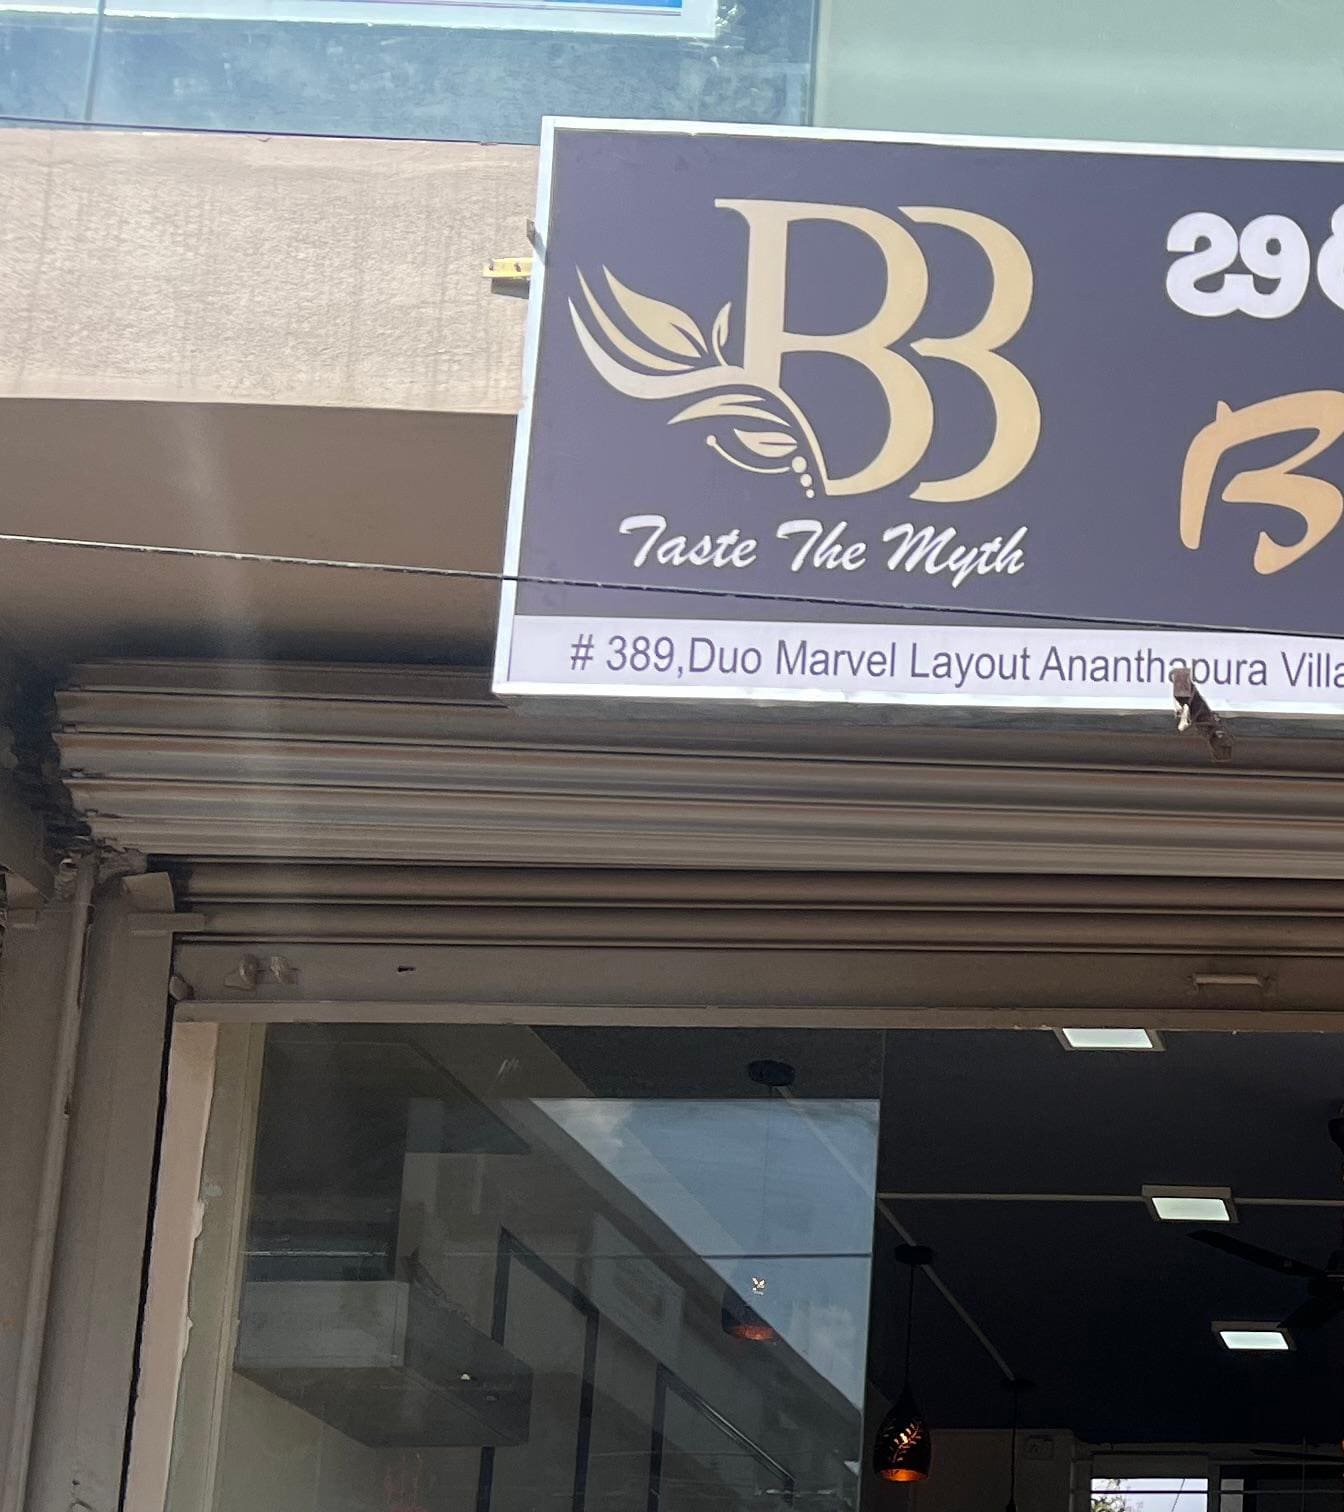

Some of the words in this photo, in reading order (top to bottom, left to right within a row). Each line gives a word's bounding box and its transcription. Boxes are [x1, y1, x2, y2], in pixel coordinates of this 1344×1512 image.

[618, 514, 757, 570] Taste
[776, 520, 866, 573] The
[883, 522, 1029, 588] Myth
[570, 634, 596, 672] #
[775, 640, 897, 680] Marvel
[909, 640, 1031, 689] Layout
[1039, 645, 1268, 686] Ananthapura
